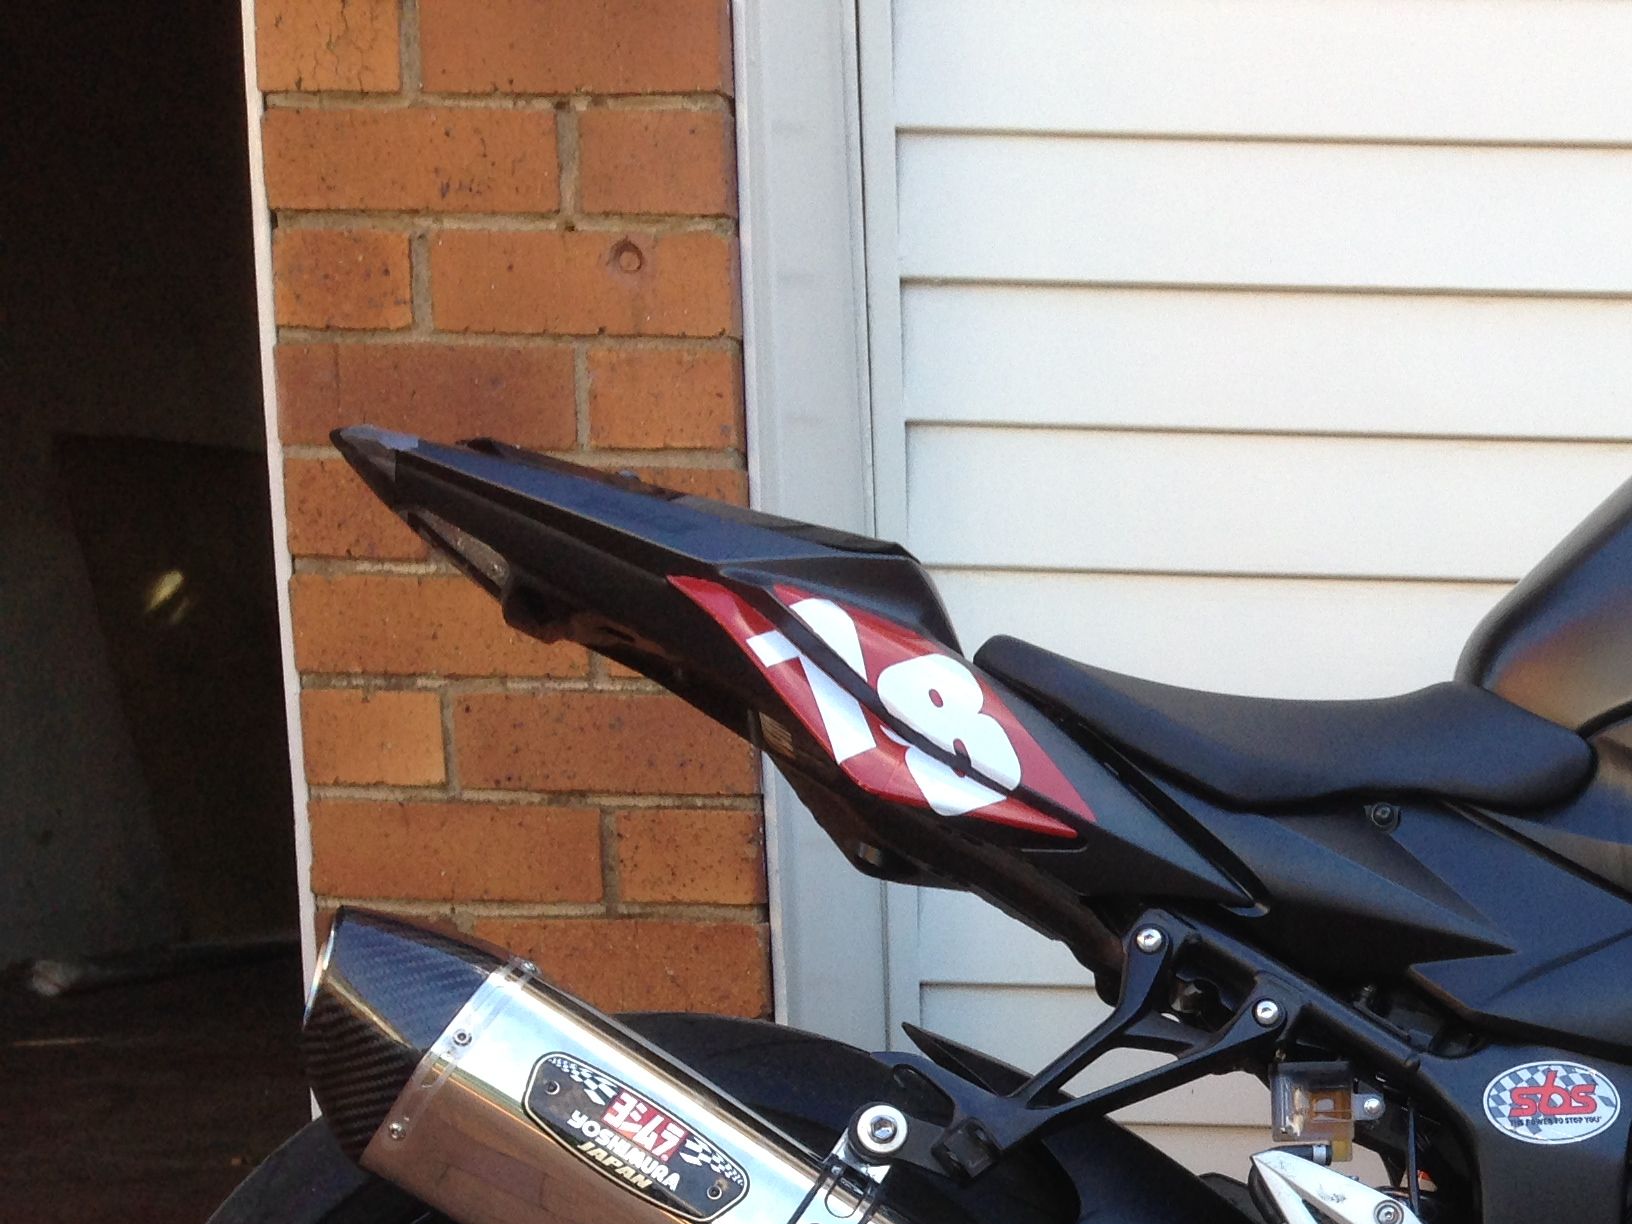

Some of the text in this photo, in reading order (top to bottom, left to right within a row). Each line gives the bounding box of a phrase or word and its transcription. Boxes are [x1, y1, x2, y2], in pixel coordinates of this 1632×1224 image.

[746, 597, 1021, 817] 78
[566, 1109, 681, 1192] YOSHIMURA
[577, 1141, 653, 1189] JAPAN
